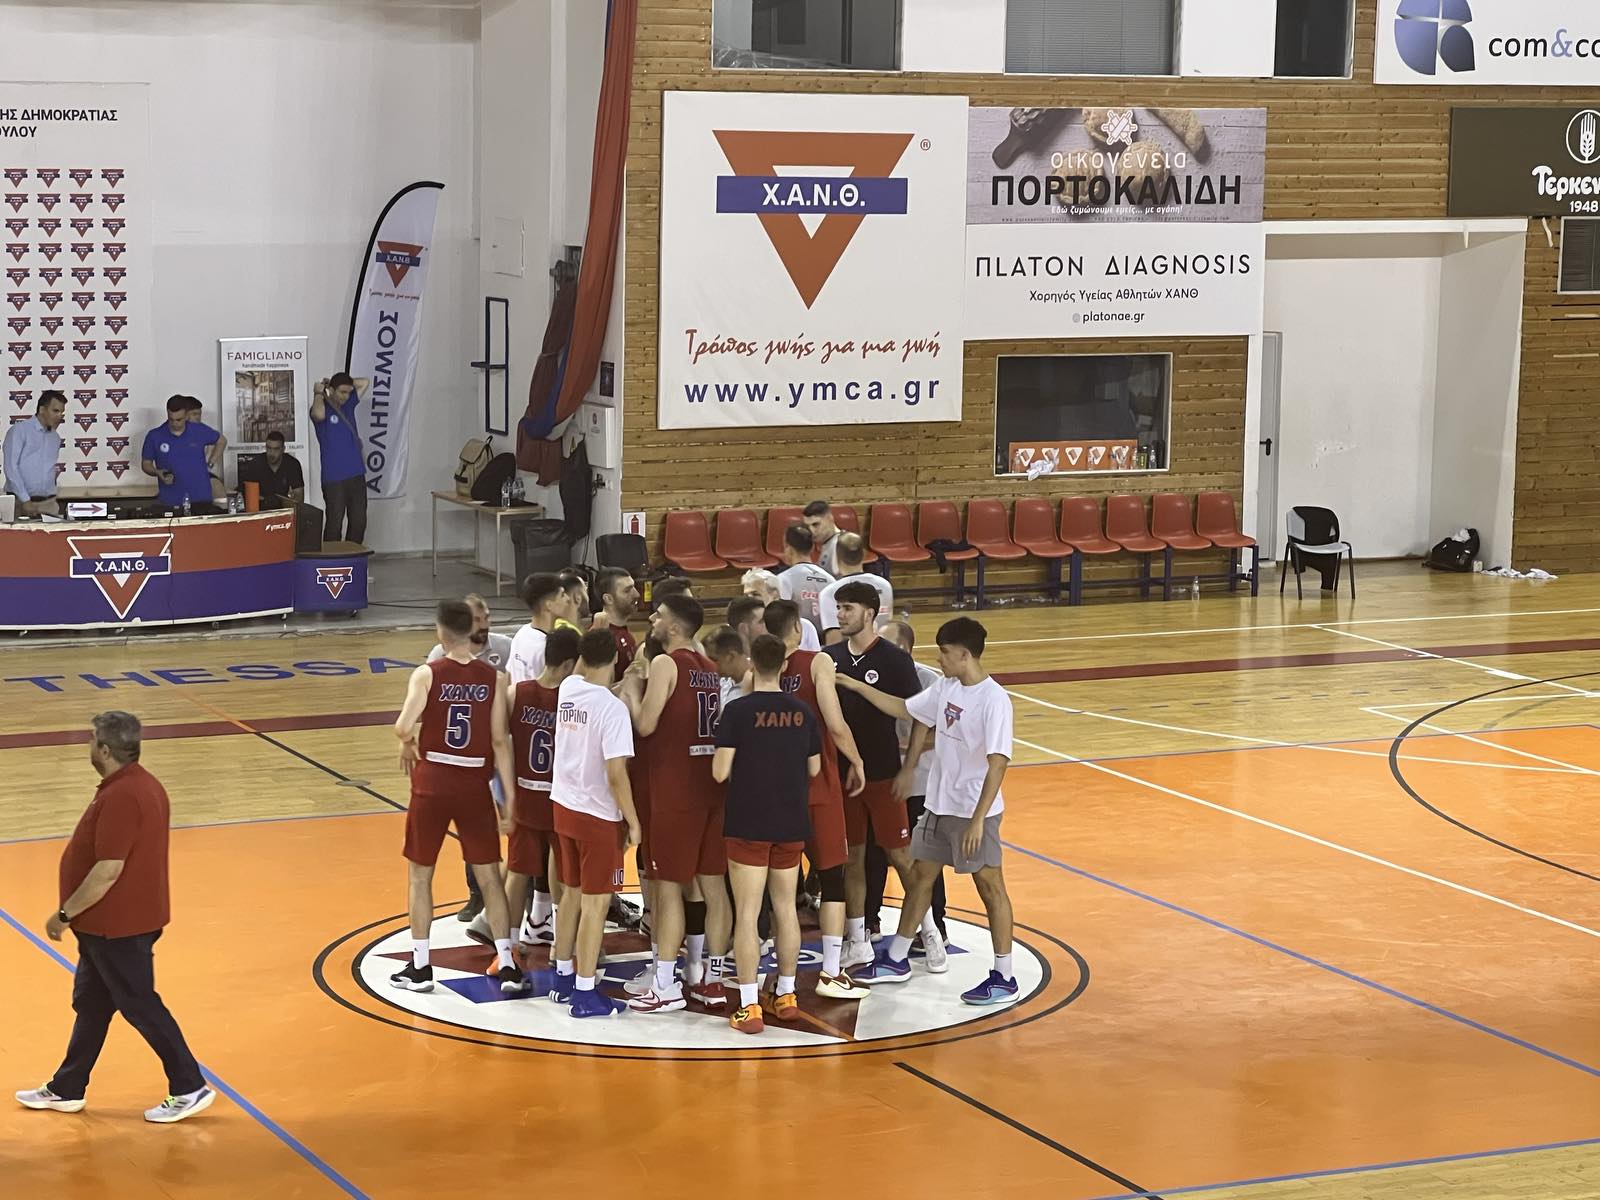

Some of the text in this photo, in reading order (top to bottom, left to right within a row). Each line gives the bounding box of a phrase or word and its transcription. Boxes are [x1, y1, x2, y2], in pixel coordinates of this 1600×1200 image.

[21, 109, 118, 121] ΔΗΜΟΚΡΑΤΙΑΣ
[0, 126, 37, 137] ΥΛΟΥ
[1051, 146, 1187, 174] οικογένεια
[762, 183, 866, 207] Χ.Α.Ν.Θ.
[992, 175, 1241, 206] ΠΟΡΤΟΚΑΛΙΔΗ
[1145, 207, 1154, 215] με
[1569, 200, 1599, 213] 1948
[1029, 287, 1199, 303] Χορηγός Υγείας Αθλητών ΧΑΝΘ
[1082, 310, 1145, 324] platonae.gr
[227, 351, 303, 361] FAMIGLIANO
[685, 329, 757, 364] Τρόπος
[862, 339, 896, 359] μια
[366, 310, 399, 494] ΑΘΛΗΤΙΣΜΟΣ
[685, 378, 940, 408] www.ymca.gr
[94, 559, 149, 573] Χ.Α.Ν.Θ.
[438, 683, 489, 702] ΧΑΝΘ
[444, 703, 472, 749] 5
[520, 705, 556, 729] ΧΑΝ
[754, 711, 804, 728] ΧΑΝΘ
[529, 728, 554, 774] 6
